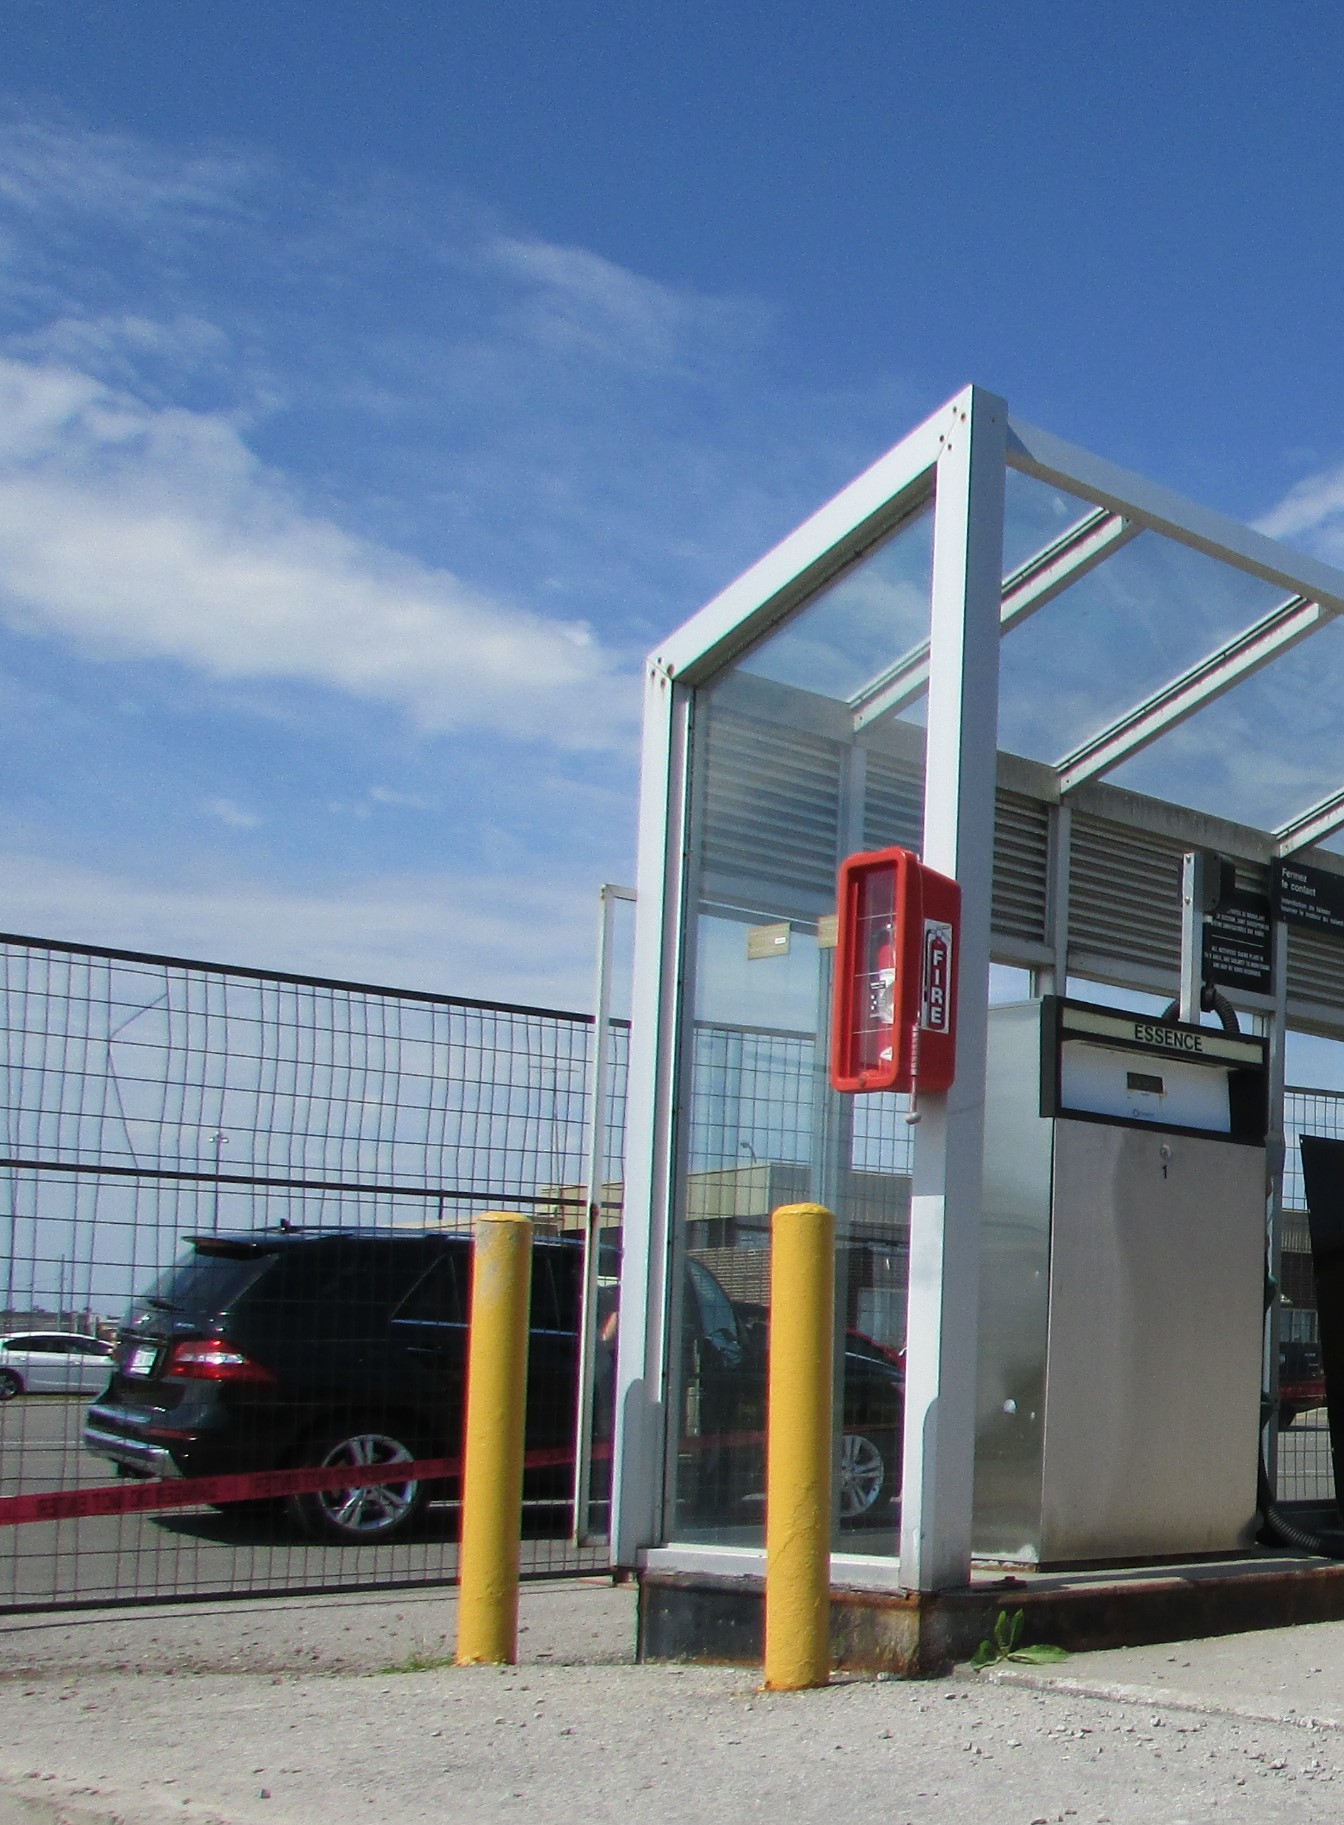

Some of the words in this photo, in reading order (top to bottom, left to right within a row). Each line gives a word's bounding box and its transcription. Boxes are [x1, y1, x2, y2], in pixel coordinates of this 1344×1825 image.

[1282, 867, 1307, 882] Fermez
[1281, 879, 1289, 889] le
[1291, 884, 1316, 896] contact
[931, 950, 943, 1023] FIRE
[1135, 1023, 1203, 1052] ESSENCE
